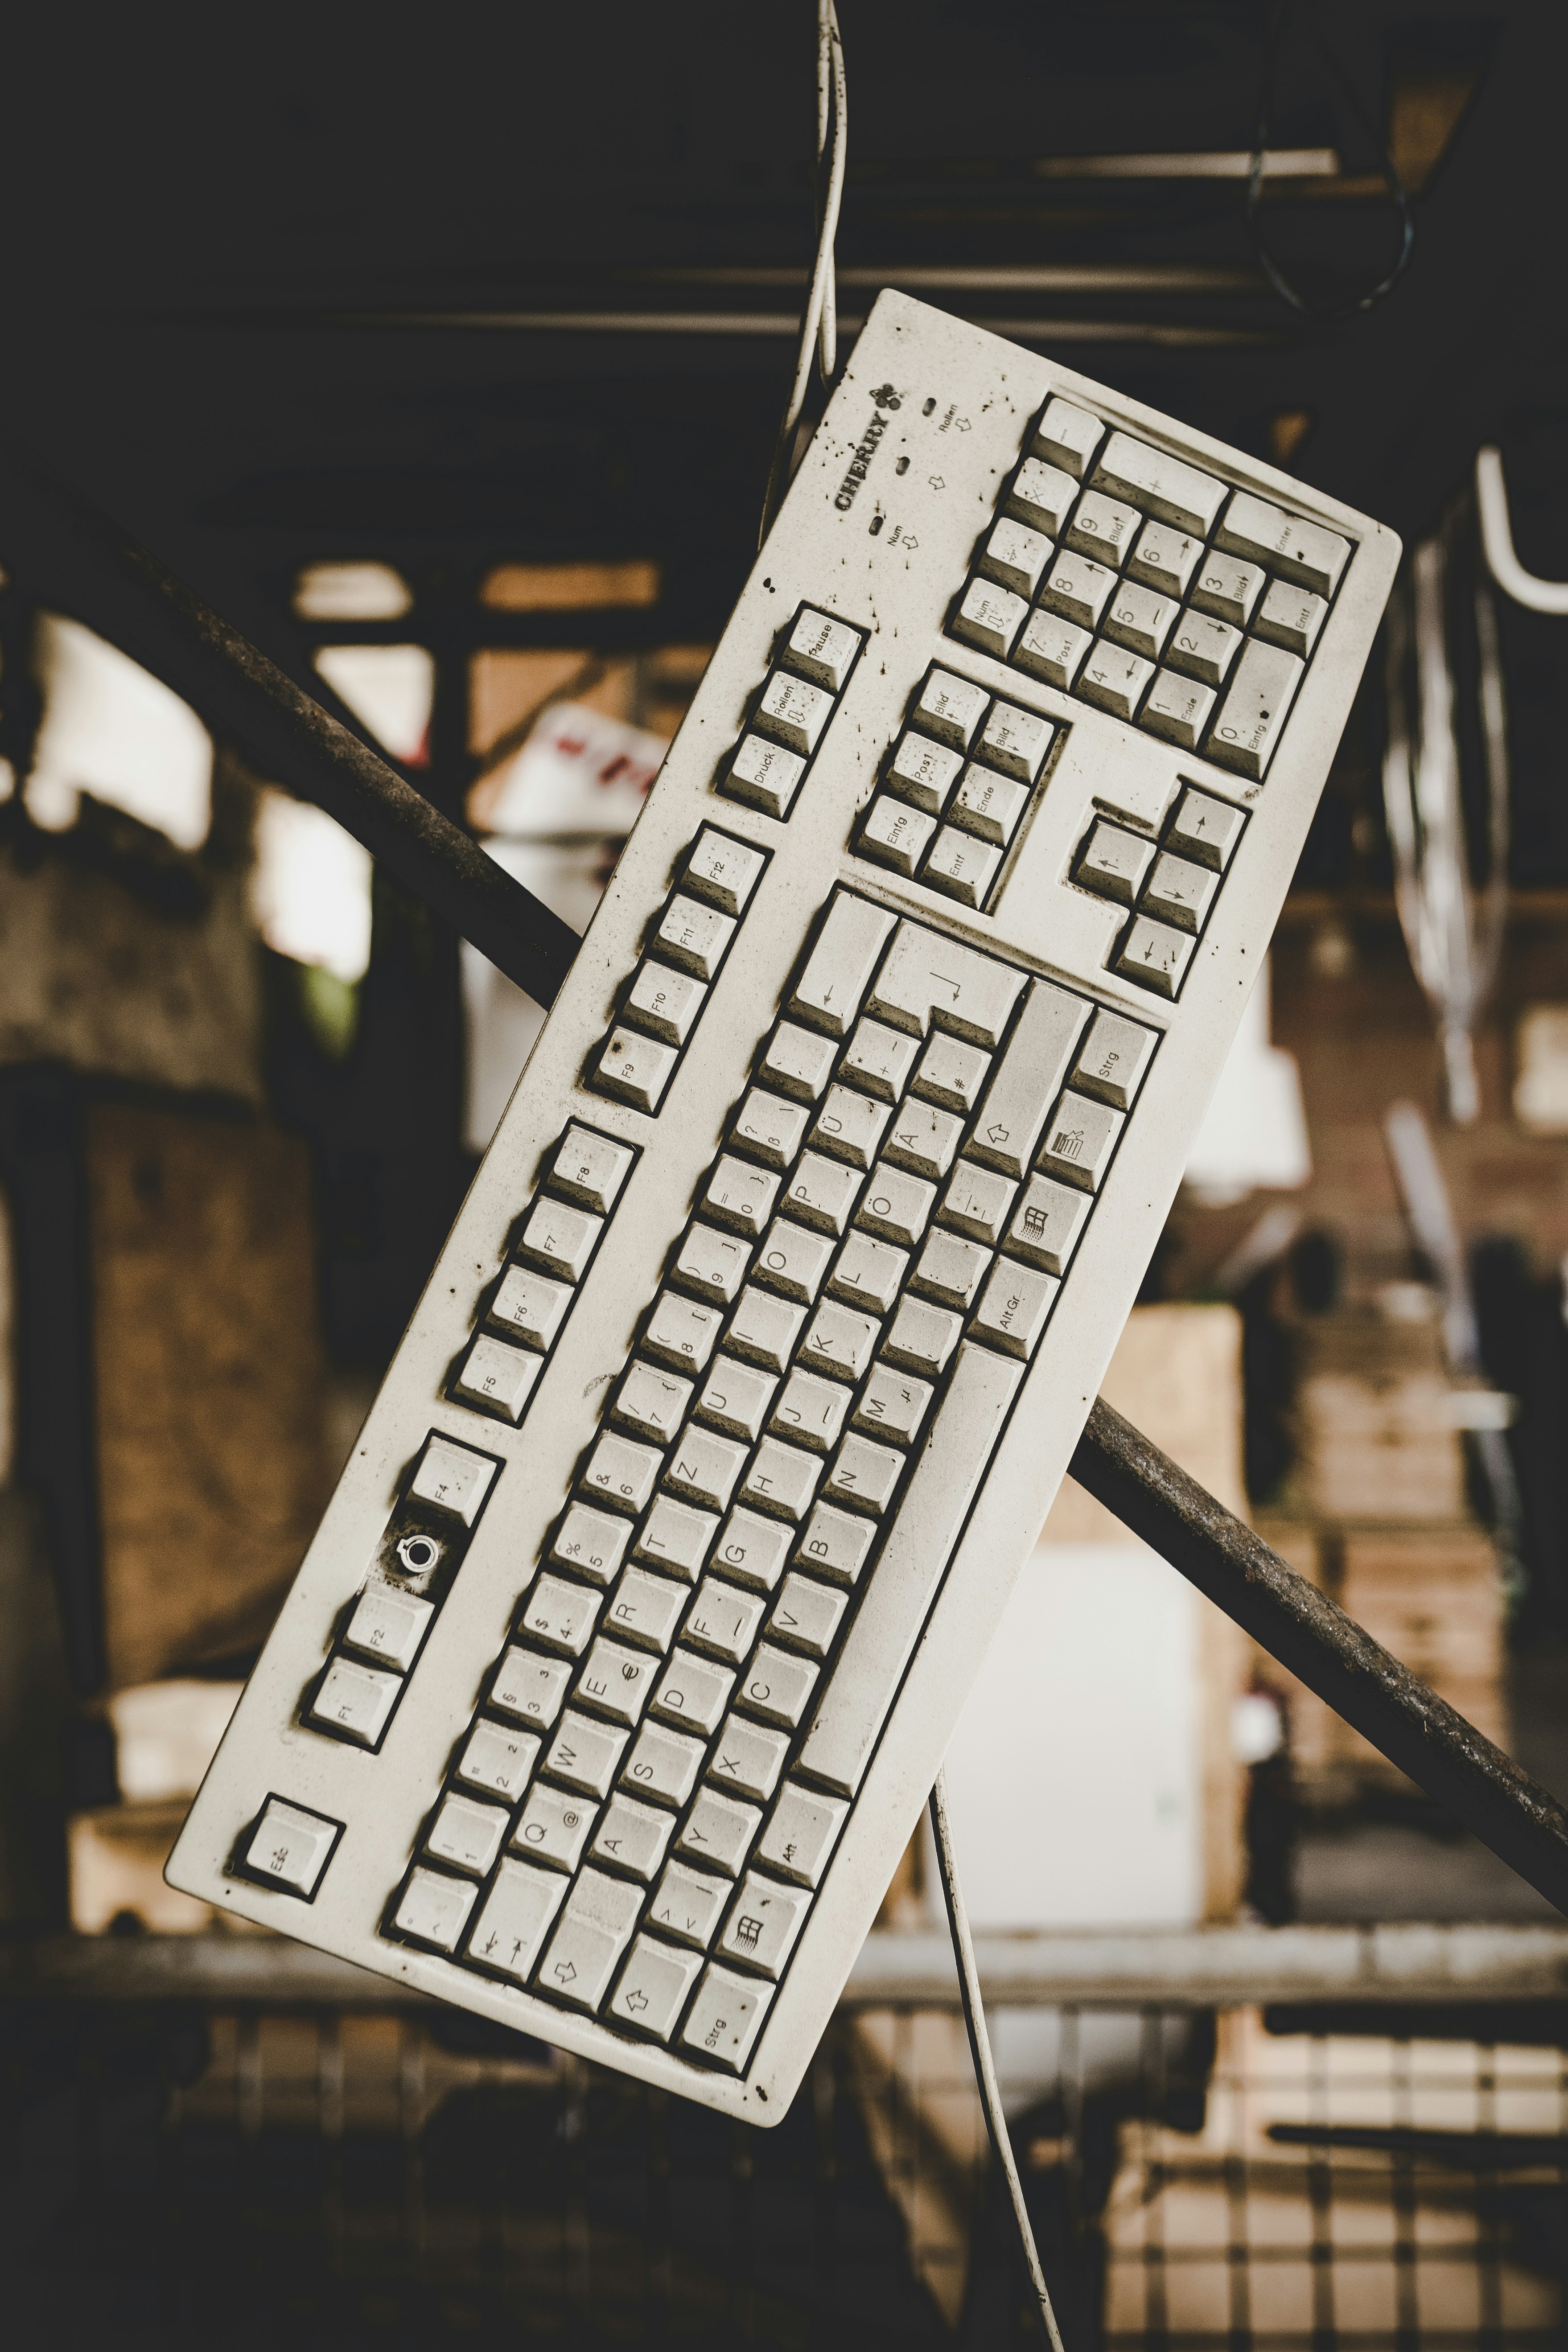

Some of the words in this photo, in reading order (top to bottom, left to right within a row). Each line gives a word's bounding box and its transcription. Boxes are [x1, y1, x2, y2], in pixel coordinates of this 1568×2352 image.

[937, 403, 958, 433] Rollen
[833, 409, 889, 513] CHERRY
[1079, 517, 1099, 532] 9
[885, 524, 904, 547] Num
[1274, 525, 1293, 552] Enter
[1142, 547, 1161, 563] 6
[1054, 577, 1074, 593] 8
[1204, 576, 1224, 591] 3
[973, 599, 991, 622] Num
[1115, 607, 1135, 624] 5
[807, 623, 833, 658] Pause
[1028, 637, 1047, 653] 7
[1179, 636, 1199, 652] 2
[1054, 638, 1074, 664] Pos1
[1091, 668, 1109, 683] 4
[773, 684, 795, 717] Rollen
[1154, 701, 1172, 711] 1
[1180, 697, 1198, 720] Ende
[1219, 726, 1240, 740] 0
[753, 752, 776, 784] Druck
[913, 752, 934, 781] Pos1
[975, 785, 995, 813] Ende
[708, 860, 725, 881] F12
[678, 926, 696, 946] F11
[650, 991, 667, 1012] F10
[620, 1062, 635, 1079] F9
[1098, 1051, 1120, 1078] Strg
[953, 1077, 966, 1090] #
[743, 1124, 758, 1135] ?
[820, 1114, 843, 1134] Ü
[893, 1131, 920, 1150] Ä
[575, 1166, 591, 1184] F8
[793, 1184, 812, 1203] P
[740, 1203, 754, 1215] 0
[867, 1196, 892, 1216] Ö
[543, 1234, 557, 1252] F7
[765, 1250, 787, 1271] O
[710, 1271, 724, 1284] 9
[839, 1272, 862, 1285] L
[512, 1305, 528, 1323] F6
[998, 1310, 1014, 1330] Alt
[1006, 1294, 1021, 1311] Gr
[680, 1341, 694, 1354] 8
[811, 1333, 834, 1354] K
[481, 1375, 497, 1394] F5
[706, 1390, 728, 1410] U
[864, 1397, 887, 1419] M
[649, 1410, 663, 1424] 7
[783, 1406, 802, 1423] J
[595, 1473, 612, 1486] &
[675, 1460, 699, 1482] Z
[836, 1469, 858, 1489] N
[433, 1483, 450, 1502] F4
[619, 1482, 634, 1496] 6
[752, 1474, 774, 1494] H
[564, 1541, 582, 1557] %
[645, 1532, 666, 1548] T
[807, 1538, 829, 1558] B
[588, 1554, 603, 1568] 5
[724, 1543, 747, 1564] G
[614, 1602, 637, 1622] R
[778, 1609, 799, 1626] V
[559, 1628, 573, 1640] 4
[692, 1617, 711, 1637] F
[369, 1628, 386, 1648] F2
[621, 1661, 640, 1682] €
[584, 1677, 608, 1697] E
[749, 1681, 771, 1701] C
[526, 1700, 541, 1714] 3
[662, 1688, 685, 1709] D
[337, 1704, 353, 1722] F1
[553, 1742, 578, 1767] W
[632, 1762, 654, 1780] S
[717, 1754, 741, 1776] X
[494, 1775, 510, 1789] 2
[562, 1810, 580, 1829] @
[523, 1822, 548, 1844] Q
[687, 1826, 709, 1843] Y
[464, 1851, 478, 1861] 1
[602, 1838, 623, 1855] A
[269, 1846, 289, 1872] Esc
[704, 2017, 728, 2048] Strg
